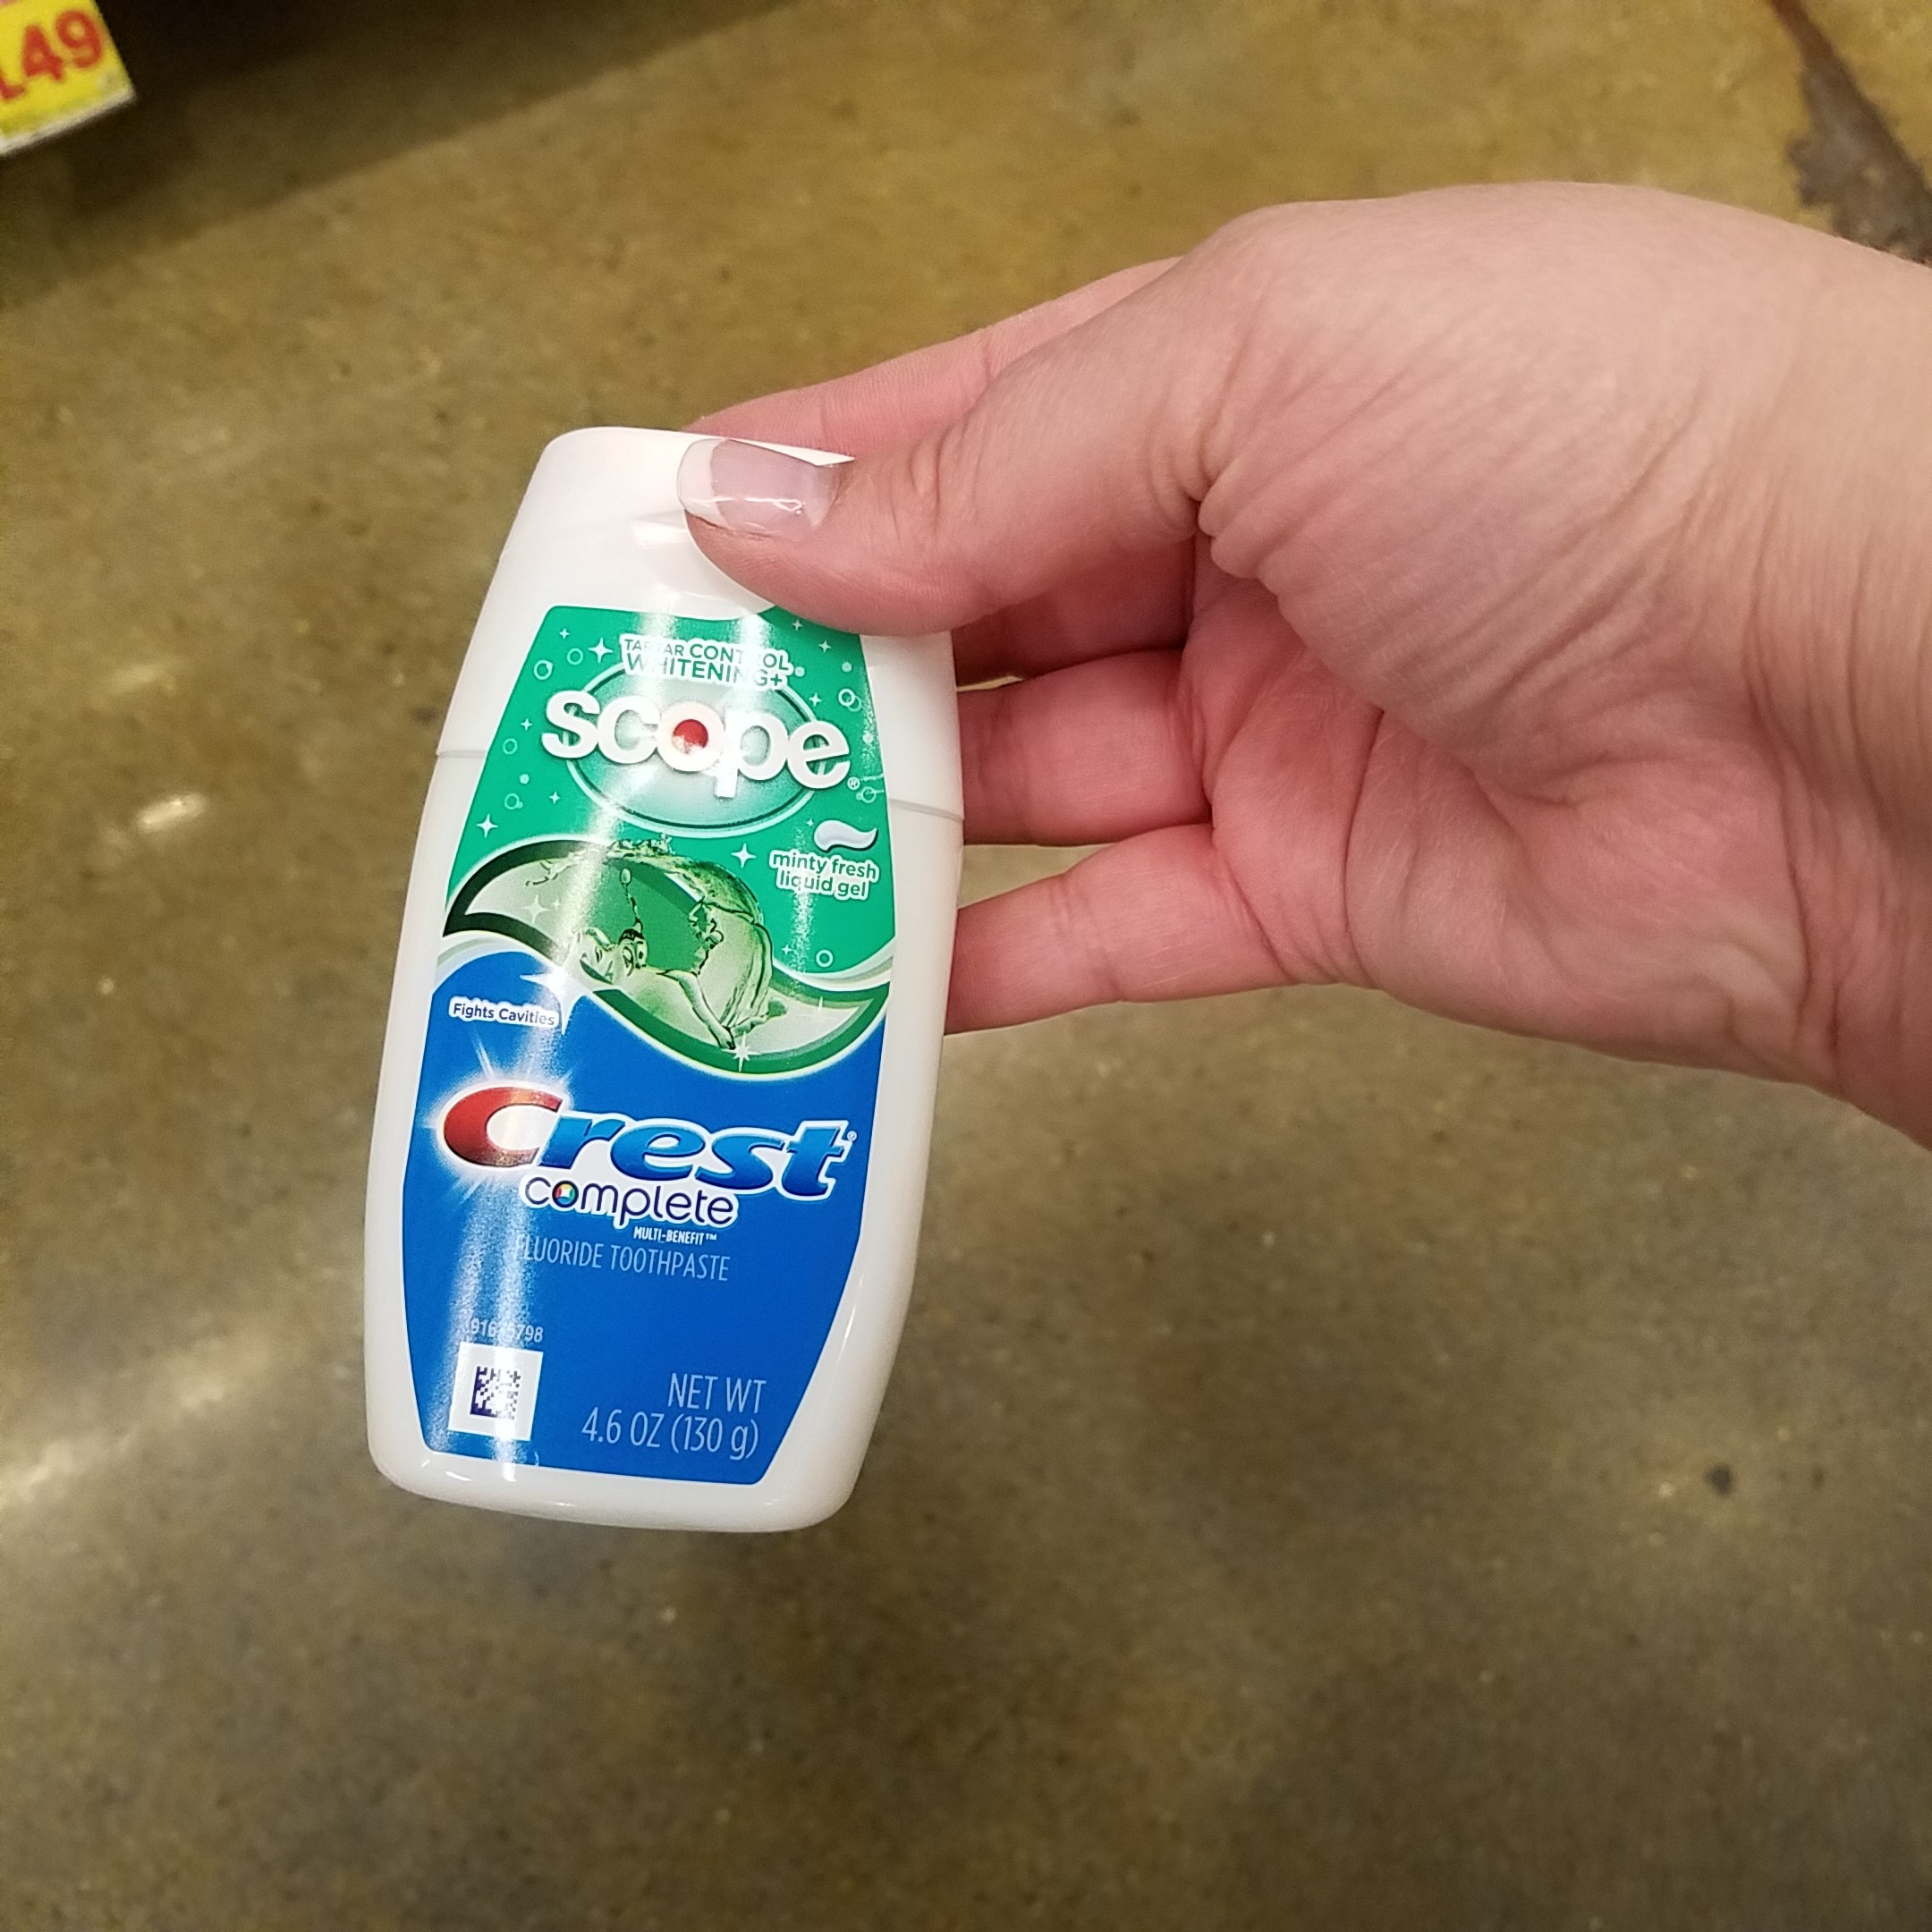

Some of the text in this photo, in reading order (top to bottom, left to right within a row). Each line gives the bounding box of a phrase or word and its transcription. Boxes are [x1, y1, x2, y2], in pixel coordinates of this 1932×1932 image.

[690, 643, 789, 671] CONTOL
[542, 691, 850, 799] scope
[773, 852, 876, 879] minty fresh
[780, 870, 866, 896] liquid gel
[453, 1003, 555, 1026] Fights Cavities
[443, 1086, 844, 1197] Crest
[524, 1176, 734, 1225] complete
[516, 1233, 730, 1282] FLUORIDE TOOTHPASTE
[668, 1373, 767, 1414] NET WT
[581, 1407, 759, 1460] 4.6 OZ (130 g)
